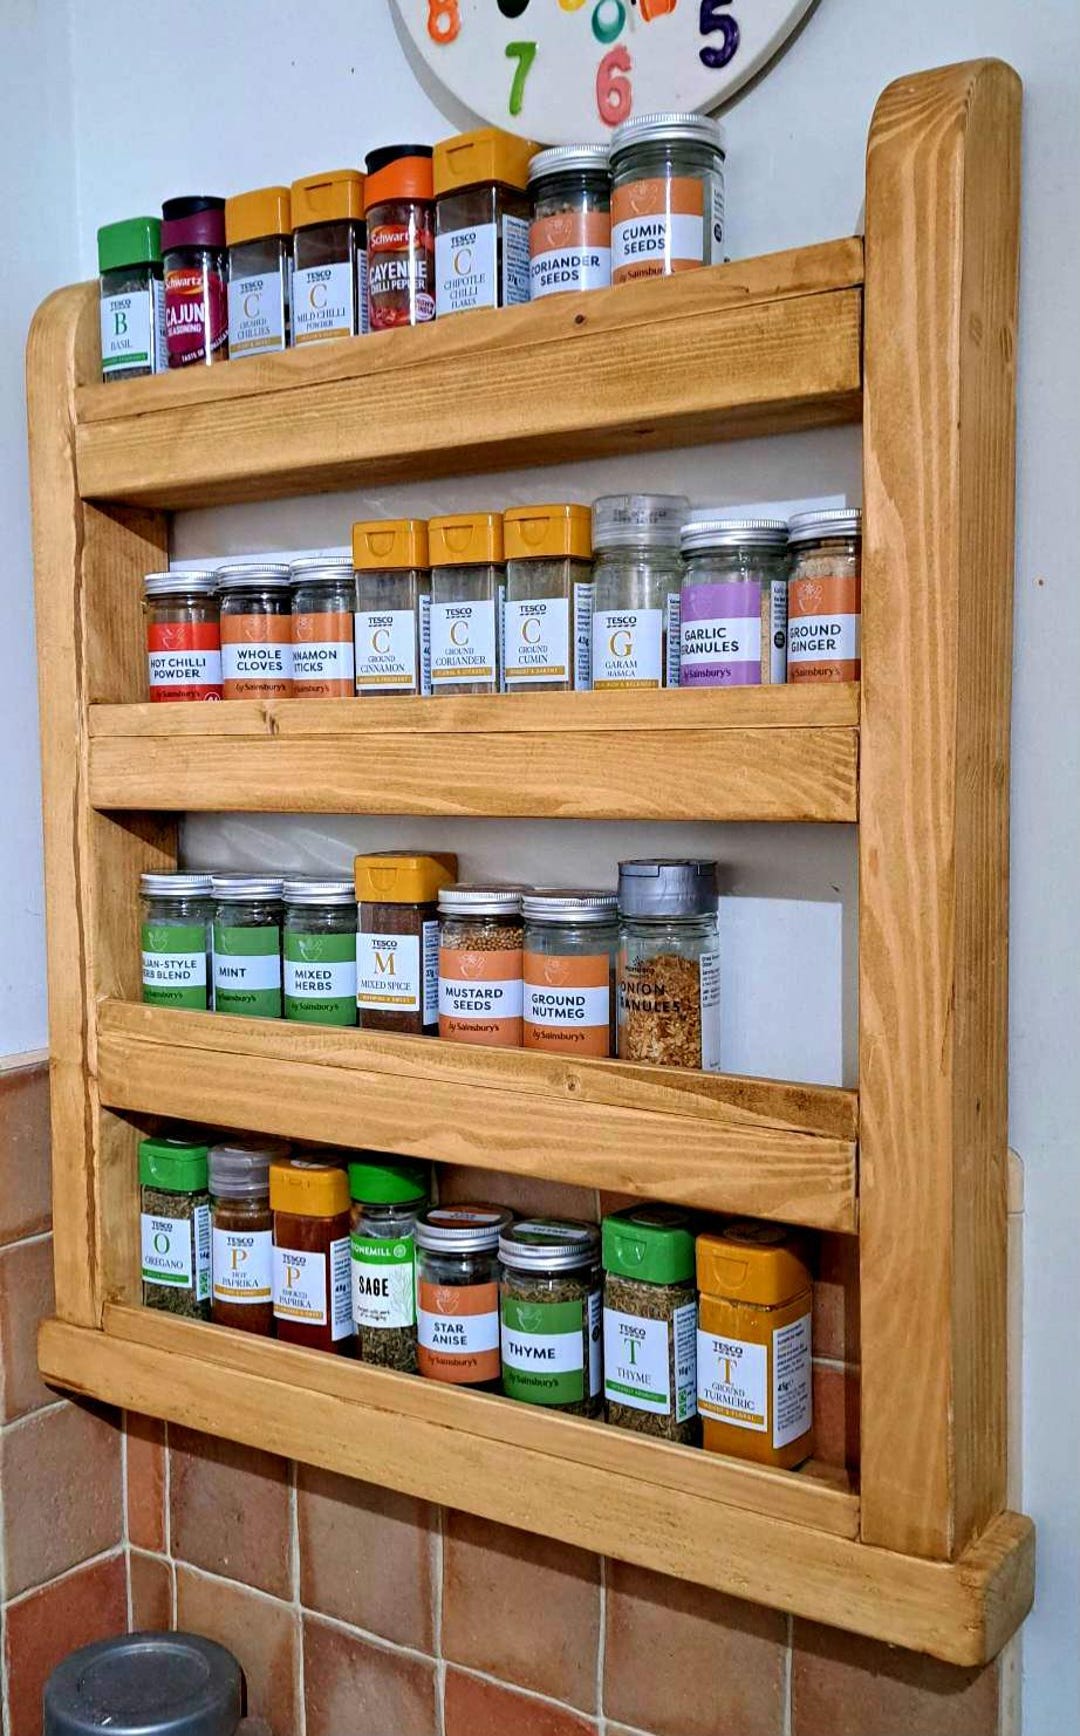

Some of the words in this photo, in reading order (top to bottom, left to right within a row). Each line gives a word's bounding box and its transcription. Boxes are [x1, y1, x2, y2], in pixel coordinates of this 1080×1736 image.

[700, 0, 740, 68] 5
[505, 41, 538, 117] 7
[596, 44, 633, 128] 6
[451, 233, 476, 244] TESCO
[622, 223, 667, 241] CUMIN
[371, 231, 418, 248] Schwart
[624, 238, 665, 256] SEEDS
[454, 248, 472, 275] C
[531, 255, 600, 276] CORIANDER
[307, 270, 331, 280] TESCO
[370, 260, 427, 284] CAYENNE
[540, 270, 579, 286] SEEDS
[627, 265, 675, 278] Sainsbur
[240, 280, 263, 290] TESCO
[443, 273, 486, 290] CHIPOTLE
[310, 284, 327, 309] C
[449, 286, 477, 299] CHILLI
[110, 299, 131, 308] TESCO
[244, 293, 260, 319] C
[166, 303, 205, 327] CAJUN
[316, 308, 345, 319] CHILLI
[115, 312, 128, 335] B
[306, 320, 333, 331] POWDER
[237, 327, 270, 340] CHILLIES
[111, 340, 130, 350] BASIL
[445, 609, 472, 617] TESCO
[519, 604, 547, 613] TESCO
[368, 617, 393, 625] TESCO
[606, 616, 637, 624] TESCO
[449, 621, 469, 646] C
[521, 618, 541, 644] C
[684, 627, 727, 642] GARLIC
[790, 624, 842, 639] GROUND
[371, 630, 390, 654] C
[609, 631, 632, 657] G
[681, 641, 740, 656] GRANULES
[791, 639, 836, 652] GINGER
[237, 650, 282, 660] WHOLE
[292, 650, 337, 661] NNAMON
[444, 648, 474, 656] GROUND
[518, 646, 548, 655] GROUND
[151, 658, 165, 669] HOT
[168, 657, 206, 668] CHILLI
[237, 661, 283, 672] CLOVES
[367, 656, 396, 664] GROUND
[435, 656, 486, 667] CORIANDER
[518, 655, 548, 665] CUMIN
[605, 660, 637, 670] GARAM
[294, 662, 323, 672] TICKS
[360, 663, 405, 673] CINNAMON
[689, 668, 731, 679] Sainsbury's
[154, 669, 201, 679] POWDER
[244, 683, 286, 694] Sainsbury's
[372, 939, 398, 947] TESCO
[374, 952, 395, 976] M
[157, 970, 191, 980] BLEND
[219, 967, 247, 978] MINT
[294, 970, 332, 980] MIXED
[295, 981, 332, 991] HERBS
[361, 980, 386, 990] MIXED
[387, 981, 411, 991] SPICE
[620, 980, 665, 996] ONION
[445, 986, 504, 999] MUSTARD
[453, 1000, 492, 1011] SEEDS
[531, 993, 586, 1006] GROUND
[620, 997, 680, 1012] ANULES
[532, 1005, 585, 1019] NUTMEG
[456, 1021, 500, 1032] Sainsbury's
[541, 1030, 585, 1042] Sainsbury's
[151, 1221, 173, 1229] TESCO
[154, 1233, 170, 1255] O
[227, 1237, 254, 1245] TESCO
[354, 1244, 391, 1256] ONEMILL
[145, 1255, 184, 1269] OREGANO
[231, 1249, 248, 1270] P
[222, 1277, 259, 1288] PAPRIKA
[286, 1266, 300, 1289] P
[359, 1276, 389, 1297] SAGE
[279, 1296, 311, 1309] PAPRIKA
[434, 1322, 464, 1333] STAR
[619, 1324, 646, 1335] TESCO
[432, 1335, 467, 1346] ANISE
[508, 1342, 556, 1360] THYME
[624, 1339, 641, 1365] T
[713, 1341, 743, 1354] TESCO
[436, 1357, 478, 1368] Sainsbury's
[617, 1367, 652, 1385] THYME
[718, 1357, 737, 1384] T
[516, 1374, 559, 1388] Sainsbury's
[704, 1388, 755, 1410] TURMERIC
